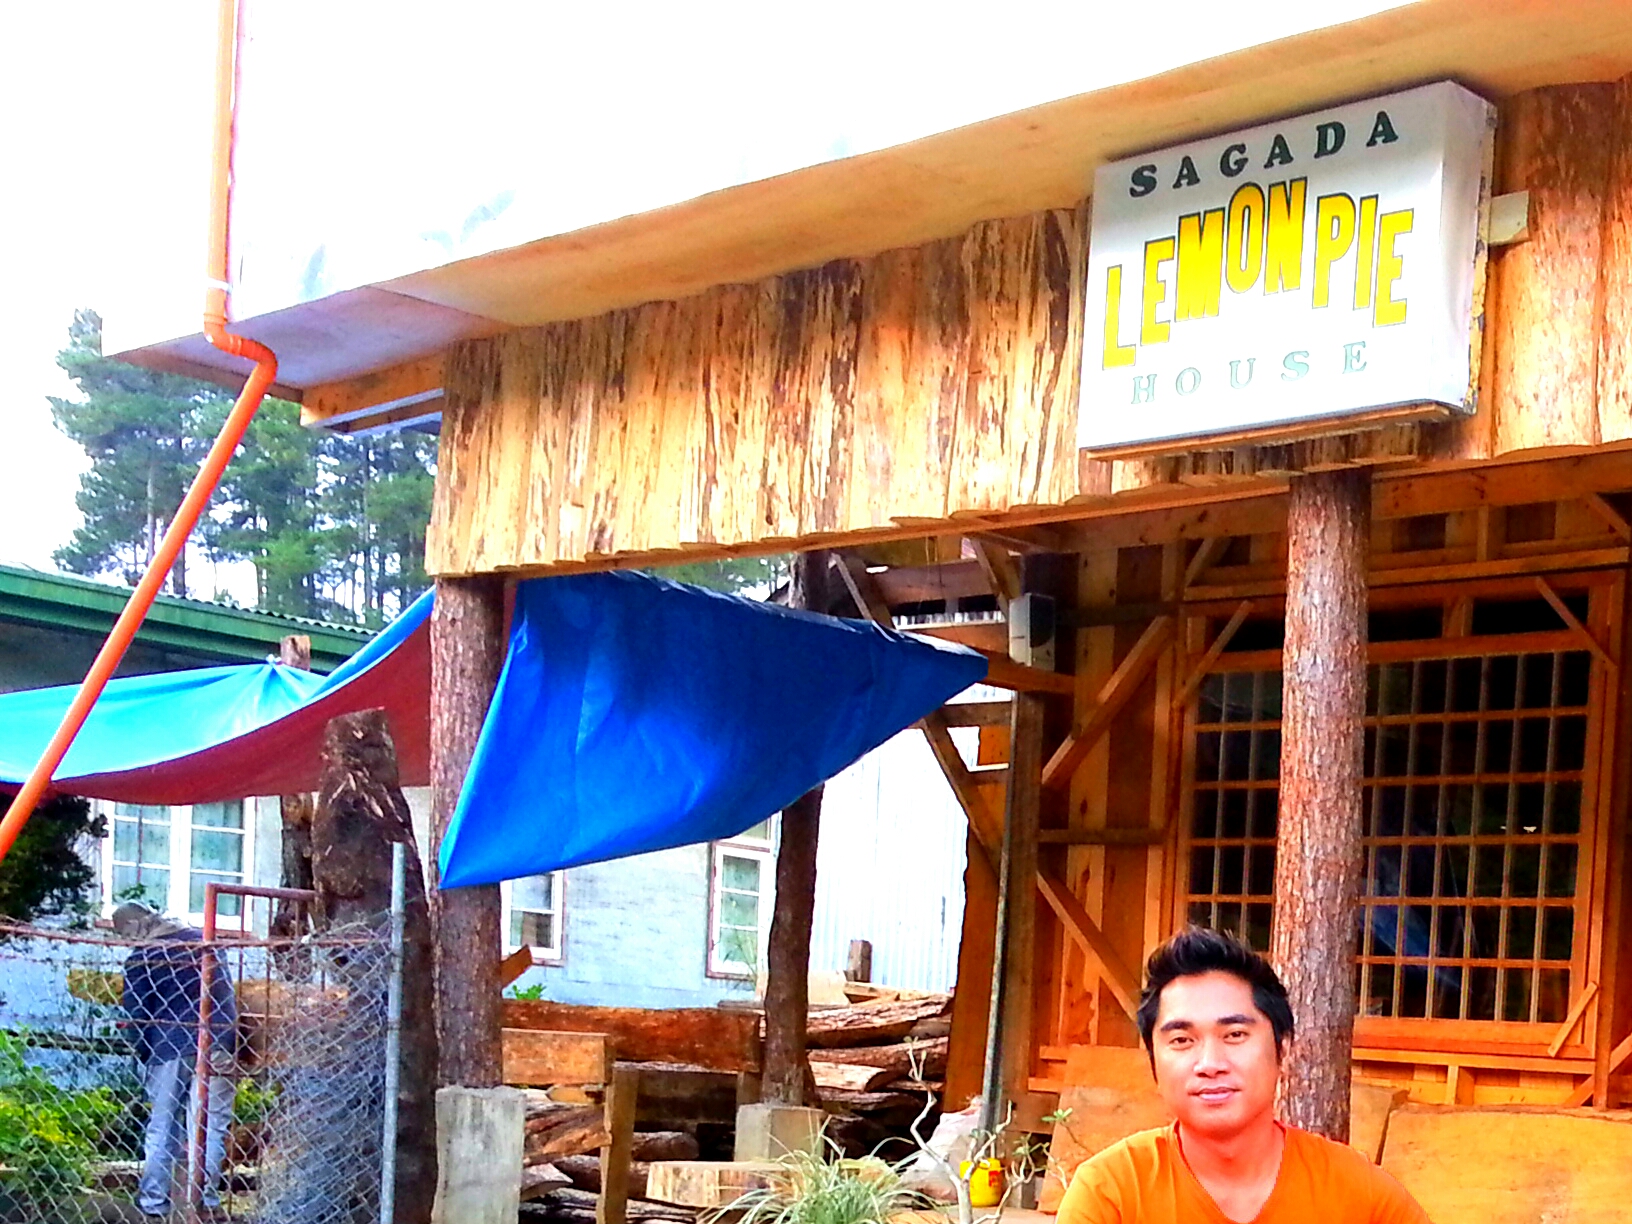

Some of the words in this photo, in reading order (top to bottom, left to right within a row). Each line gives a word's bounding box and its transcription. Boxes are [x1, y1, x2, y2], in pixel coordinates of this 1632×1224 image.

[1128, 110, 1399, 198] SAGADA
[1102, 176, 1308, 371] LEMON
[1311, 191, 1414, 328] PIE
[1131, 341, 1368, 405] HOUSE
